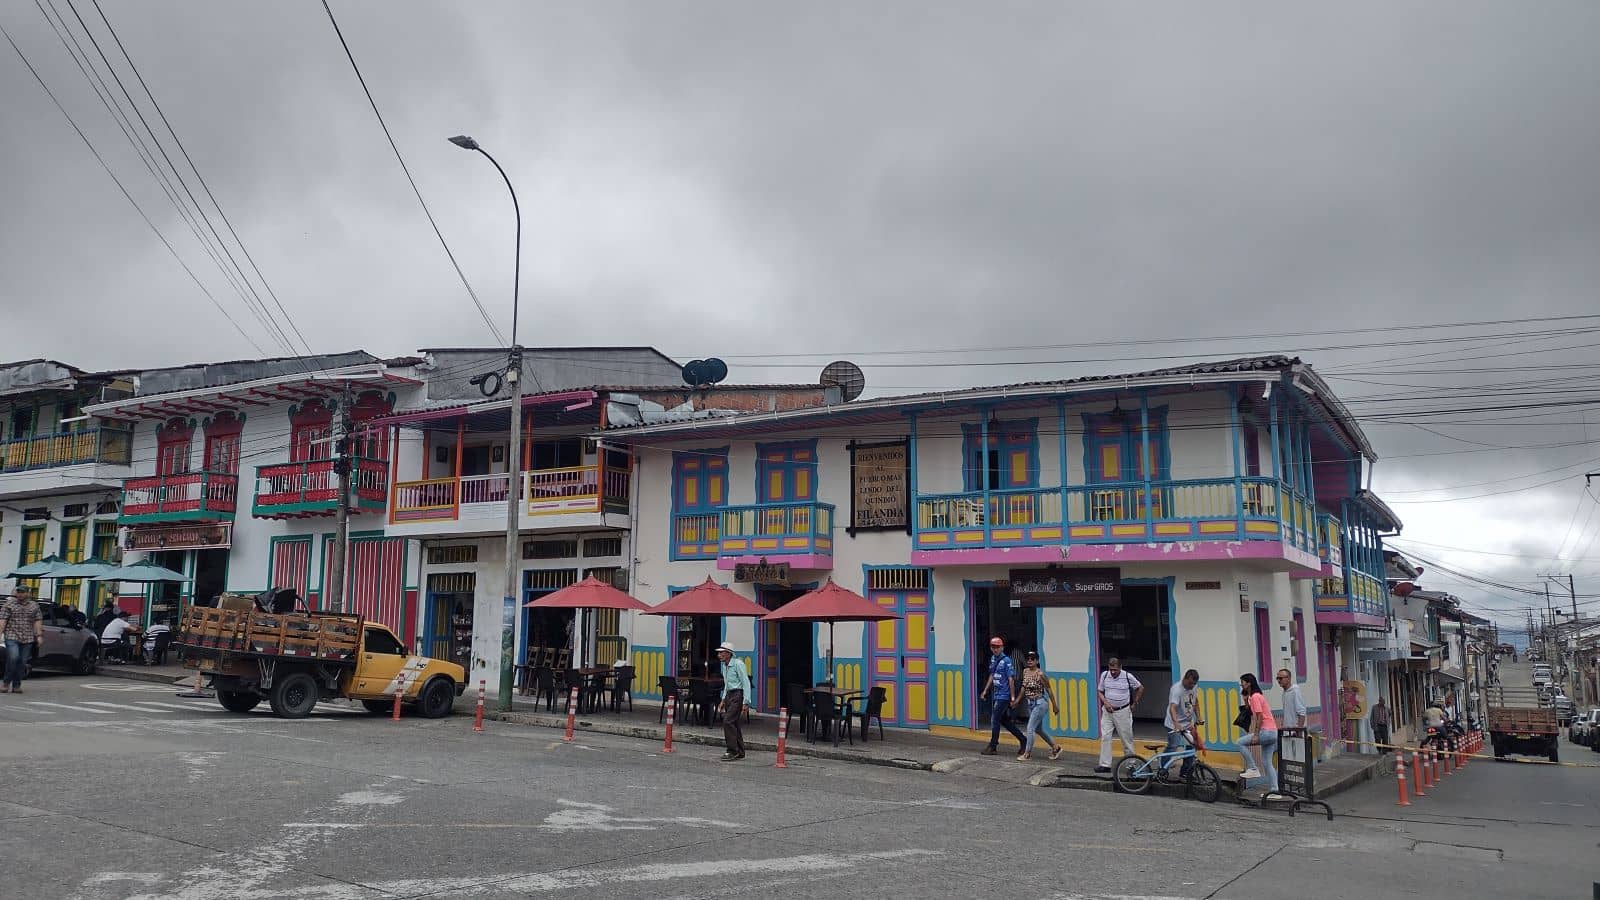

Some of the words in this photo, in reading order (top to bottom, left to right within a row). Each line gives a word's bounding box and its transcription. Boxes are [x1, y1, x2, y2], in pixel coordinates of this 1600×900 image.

[858, 452, 904, 462] BIENVENIDOS
[860, 486, 882, 494] LINDO
[857, 508, 904, 519] FILANDIA
